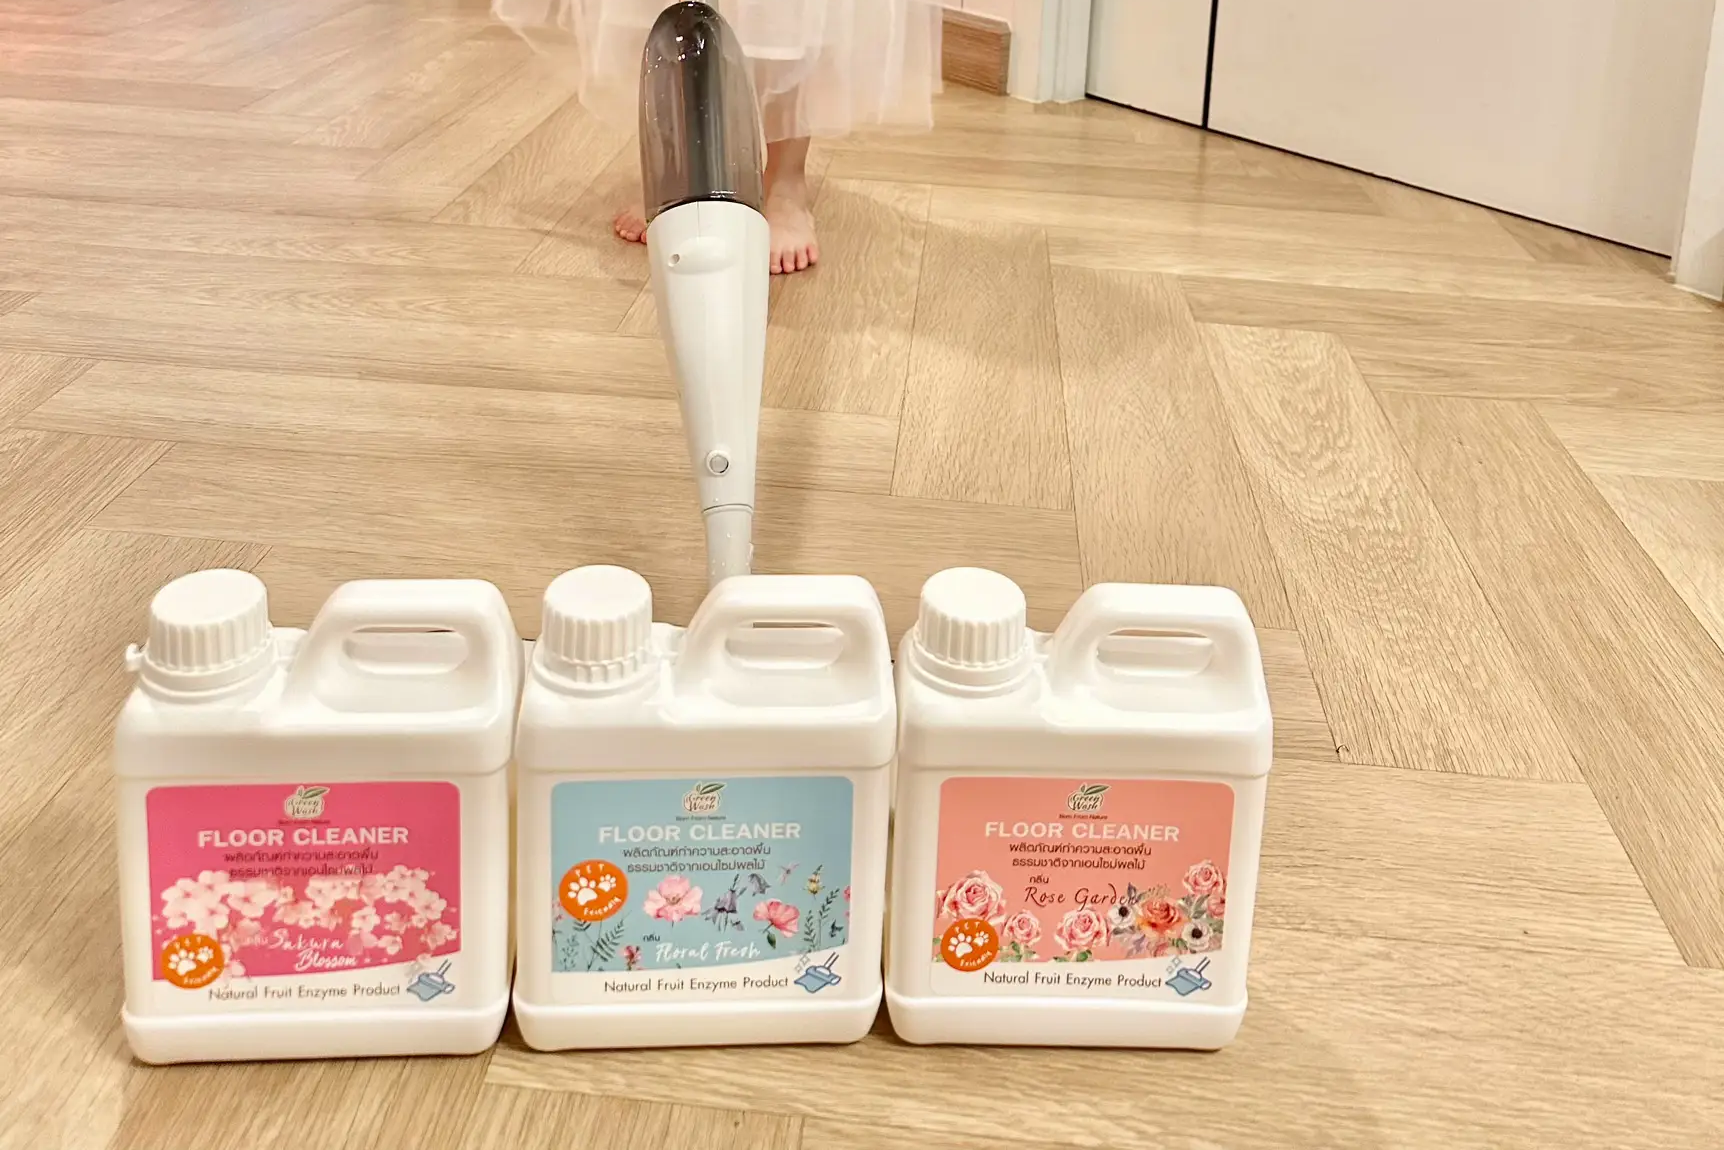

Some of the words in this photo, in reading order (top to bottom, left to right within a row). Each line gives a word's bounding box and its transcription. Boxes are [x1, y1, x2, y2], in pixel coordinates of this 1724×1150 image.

[197, 829, 285, 848] FLOOR
[293, 826, 409, 845] CLEANER
[599, 825, 681, 843] FLOOR
[689, 822, 801, 840] CLEANER
[985, 821, 1064, 838] FLOOR
[1072, 823, 1180, 842] CLEANER
[1024, 886, 1066, 907] Rose
[655, 942, 709, 962] Floral
[714, 940, 761, 961] Fresh
[604, 979, 652, 992] Natural
[657, 978, 684, 991] Fruit
[690, 978, 737, 993] Enzyme
[743, 975, 789, 988] Product
[983, 971, 1029, 984] Natural
[1034, 972, 1061, 985] Fruit
[1066, 973, 1112, 989] Enzyme
[1117, 975, 1162, 988] Product
[208, 985, 257, 1000] Natural
[264, 985, 292, 999] Fruit
[300, 984, 347, 1001] Enzyme
[353, 982, 401, 996] Product
